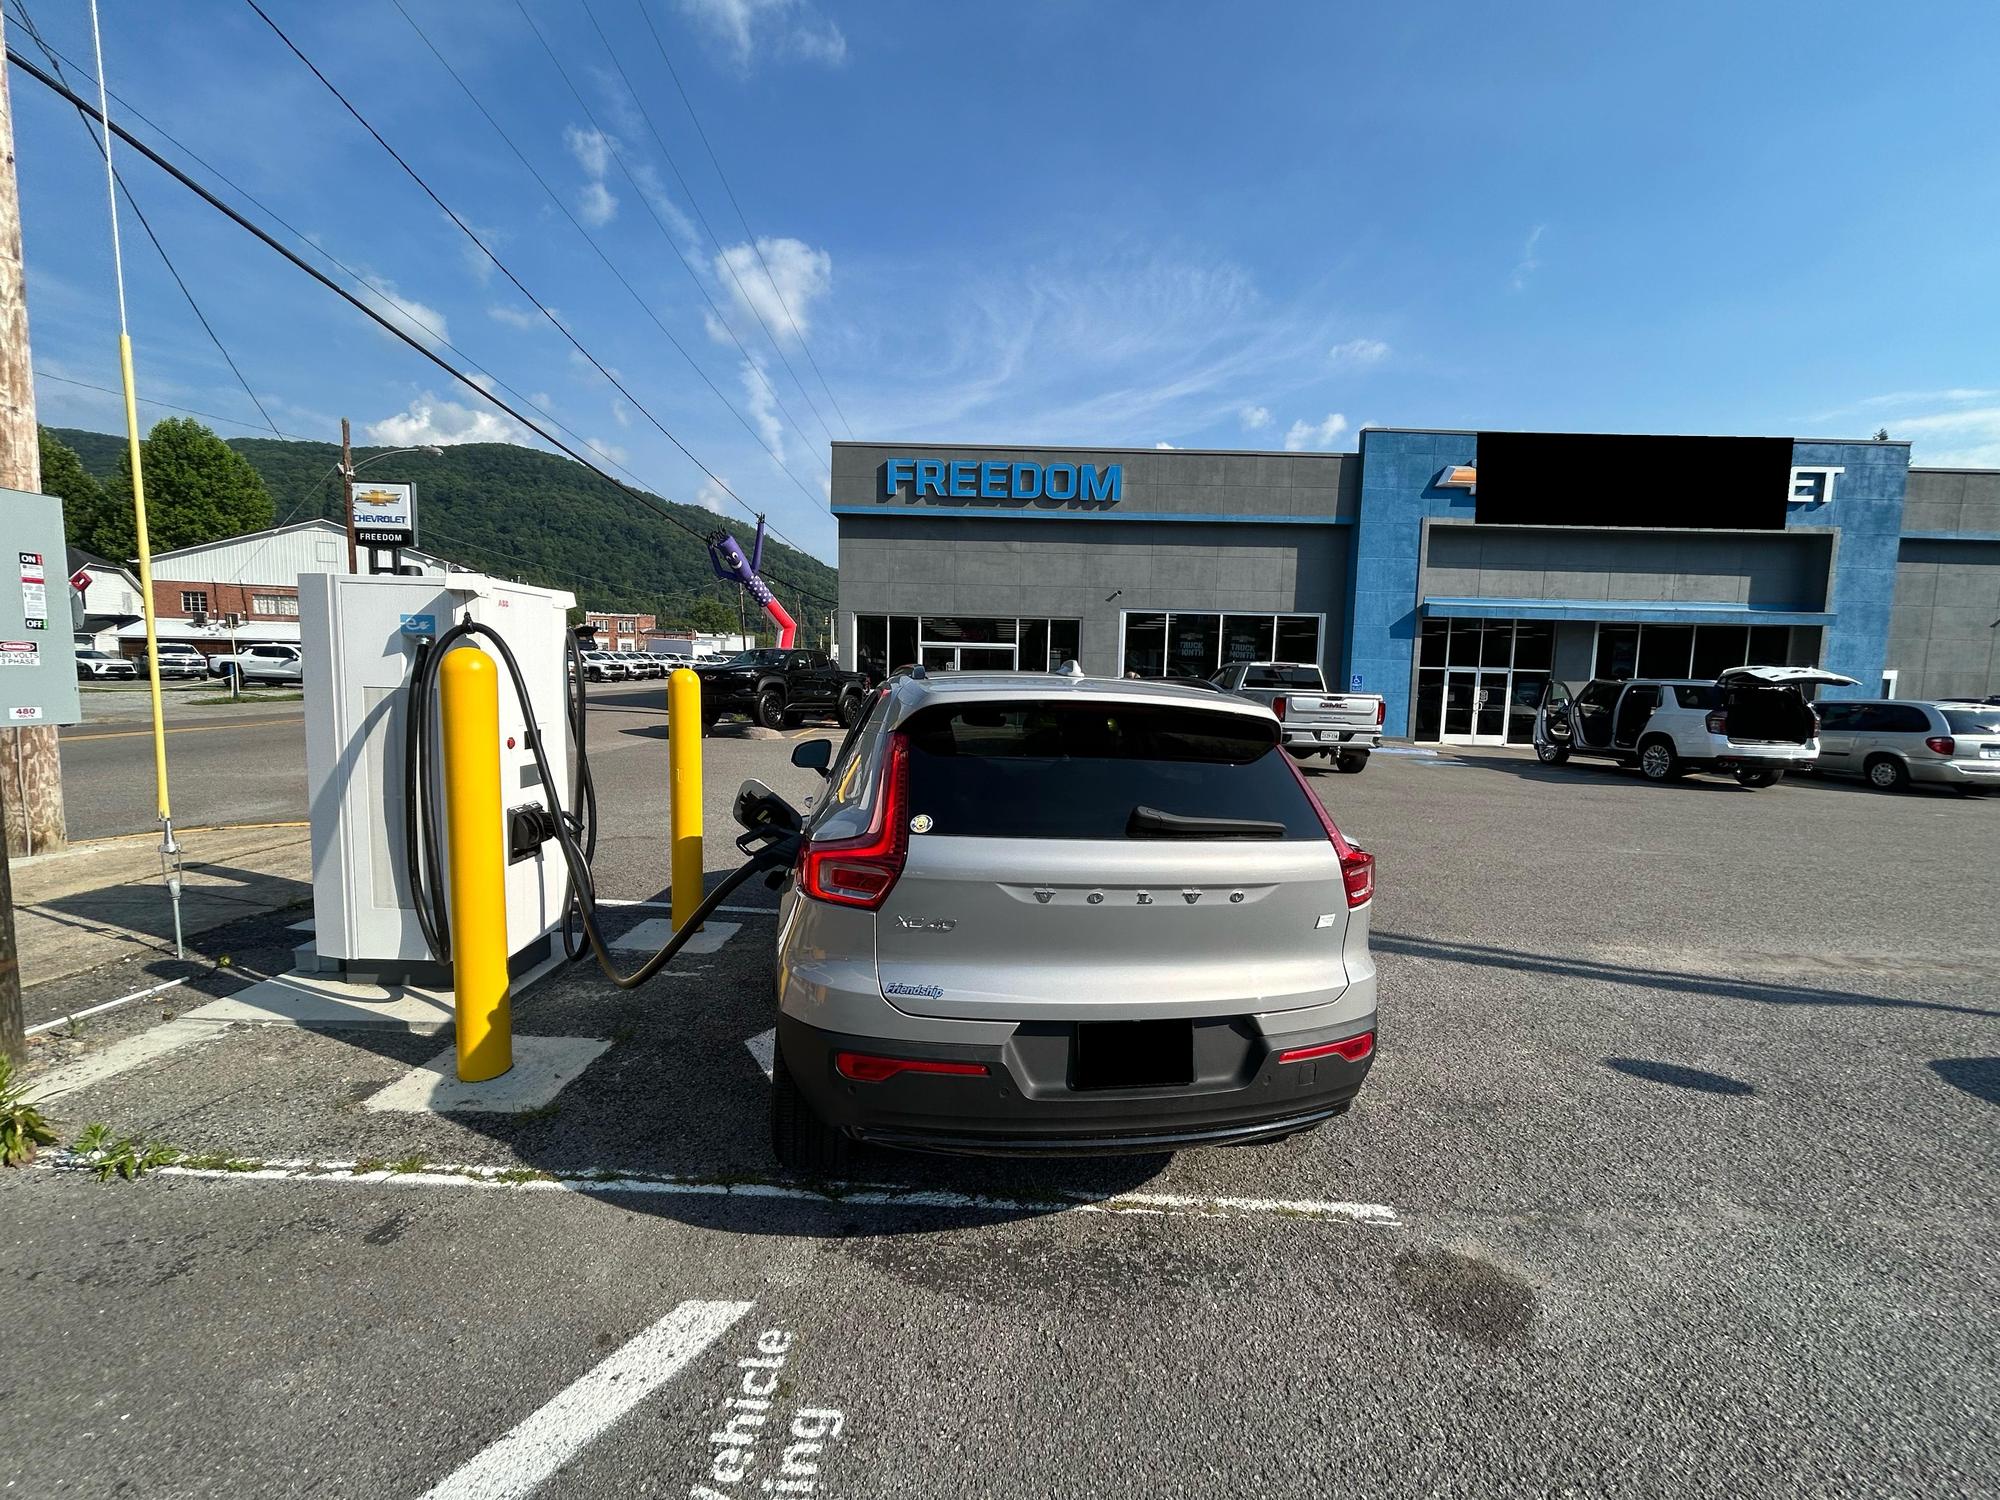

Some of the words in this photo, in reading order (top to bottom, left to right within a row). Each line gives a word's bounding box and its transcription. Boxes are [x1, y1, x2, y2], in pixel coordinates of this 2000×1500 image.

[887, 458, 1122, 501] FREEDOM
[353, 514, 406, 524] CHEVROLET
[360, 532, 402, 541] FREEDOM
[21, 554, 37, 564] ON
[26, 620, 43, 628] OFF
[1230, 643, 1255, 652] TRUCK
[1033, 887, 1245, 905] VOLVO
[885, 983, 944, 999] Friendship
